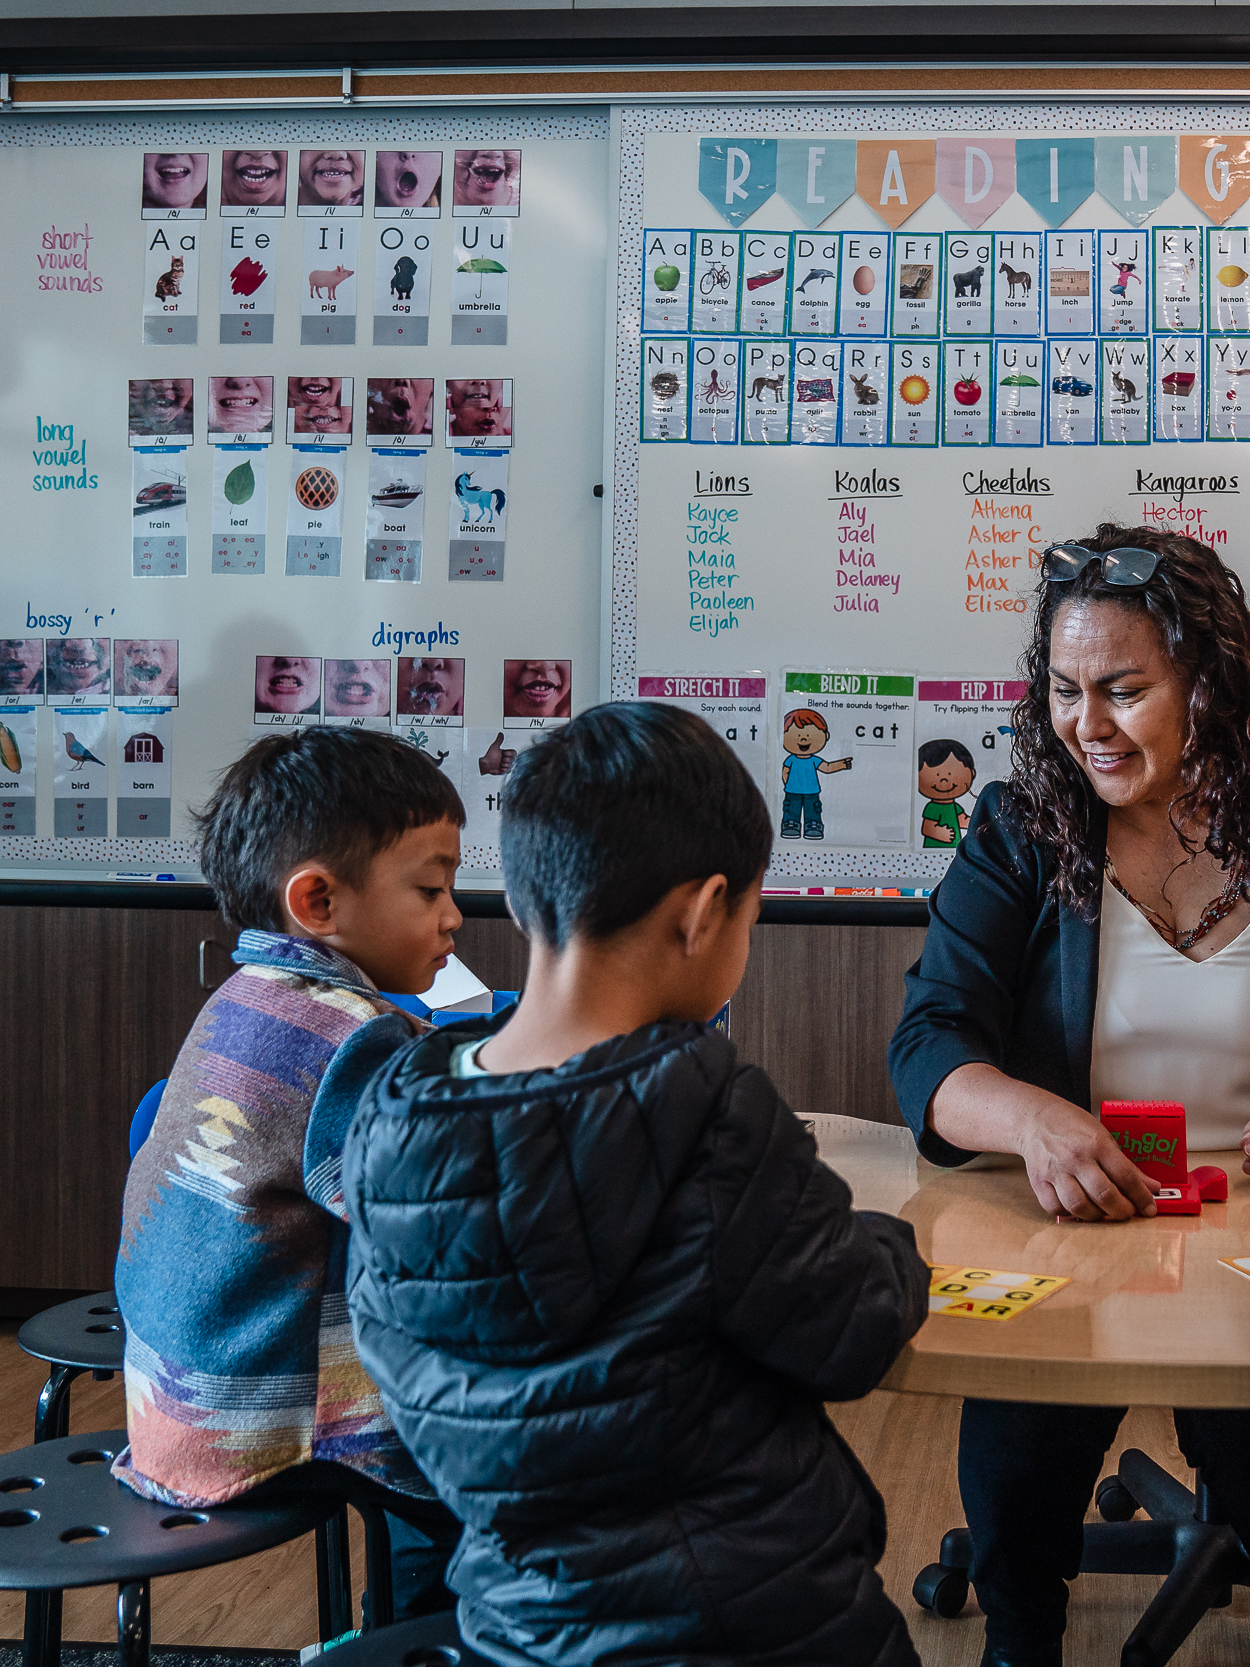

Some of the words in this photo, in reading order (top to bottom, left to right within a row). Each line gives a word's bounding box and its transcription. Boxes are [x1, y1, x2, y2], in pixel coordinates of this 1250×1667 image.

[725, 144, 1229, 205] READING
[42, 223, 93, 250] short
[37, 249, 88, 270] vowel
[38, 270, 103, 293] sounds
[240, 302, 255, 310] red
[321, 303, 336, 313] pig
[392, 303, 410, 313] dog
[459, 303, 500, 311] umbrella
[701, 298, 728, 306] bicycle
[699, 407, 729, 415] octopus
[36, 416, 74, 450] long
[32, 439, 86, 466] vowel
[32, 467, 98, 491] sounds
[696, 470, 750, 493] Lions
[835, 468, 900, 494] Koalas
[962, 468, 1050, 494] Cheetahs
[1136, 469, 1239, 502] Kangaroos
[688, 503, 738, 529] Kayce
[839, 502, 866, 527] Aly
[970, 498, 1032, 522] Athena
[1142, 502, 1208, 522] Hector
[149, 521, 170, 529] train
[230, 518, 248, 526] leaf
[308, 521, 322, 529] pie
[384, 524, 406, 532] boat
[460, 525, 496, 533] unicorn
[686, 525, 731, 545] Jack
[838, 524, 875, 544] Jael
[968, 524, 1022, 544] Asher
[1028, 526, 1048, 543] C.
[688, 549, 735, 569] Maia
[839, 548, 876, 568] Mia
[964, 550, 1022, 570] Asher
[688, 570, 740, 589] Peter
[836, 570, 900, 595] Delaney
[966, 572, 1009, 592] Max
[690, 591, 754, 611] Paoleen
[834, 593, 879, 613] Julia
[964, 594, 1027, 614] Eliseo
[25, 601, 72, 634] bossy
[690, 611, 738, 638] Elijah
[372, 621, 460, 654] digraphs
[665, 679, 722, 696] STRETCH
[729, 680, 740, 697] IT
[821, 675, 861, 694] BLEND
[867, 677, 879, 694] IT
[961, 682, 987, 700] FLIP
[993, 682, 1004, 700] IT
[5, 696, 20, 704] /or/
[71, 696, 86, 704] /er/
[138, 697, 153, 705] /ar/
[701, 704, 715, 713] Say
[718, 704, 736, 712] each
[739, 704, 762, 712] sound.
[807, 699, 828, 708] Blend
[831, 700, 843, 709] the
[846, 701, 872, 709] sounds
[876, 702, 909, 711] together.
[934, 704, 947, 713] Try
[950, 704, 978, 714] flipping
[270, 714, 286, 724] /ch/
[350, 718, 364, 726] /sh/
[410, 716, 425, 725] /w/
[431, 716, 449, 726] /wh/
[530, 718, 544, 728] /th/
[0, 781, 19, 789] corn
[72, 782, 89, 790] bird
[1132, 1155, 1150, 1163] Word
[1153, 1155, 1175, 1168] Builder
[1034, 1278, 1056, 1286] T
[939, 1284, 968, 1292] D
[1005, 1291, 1034, 1300] G
[947, 1302, 974, 1311] A
[981, 1304, 1011, 1315] R
